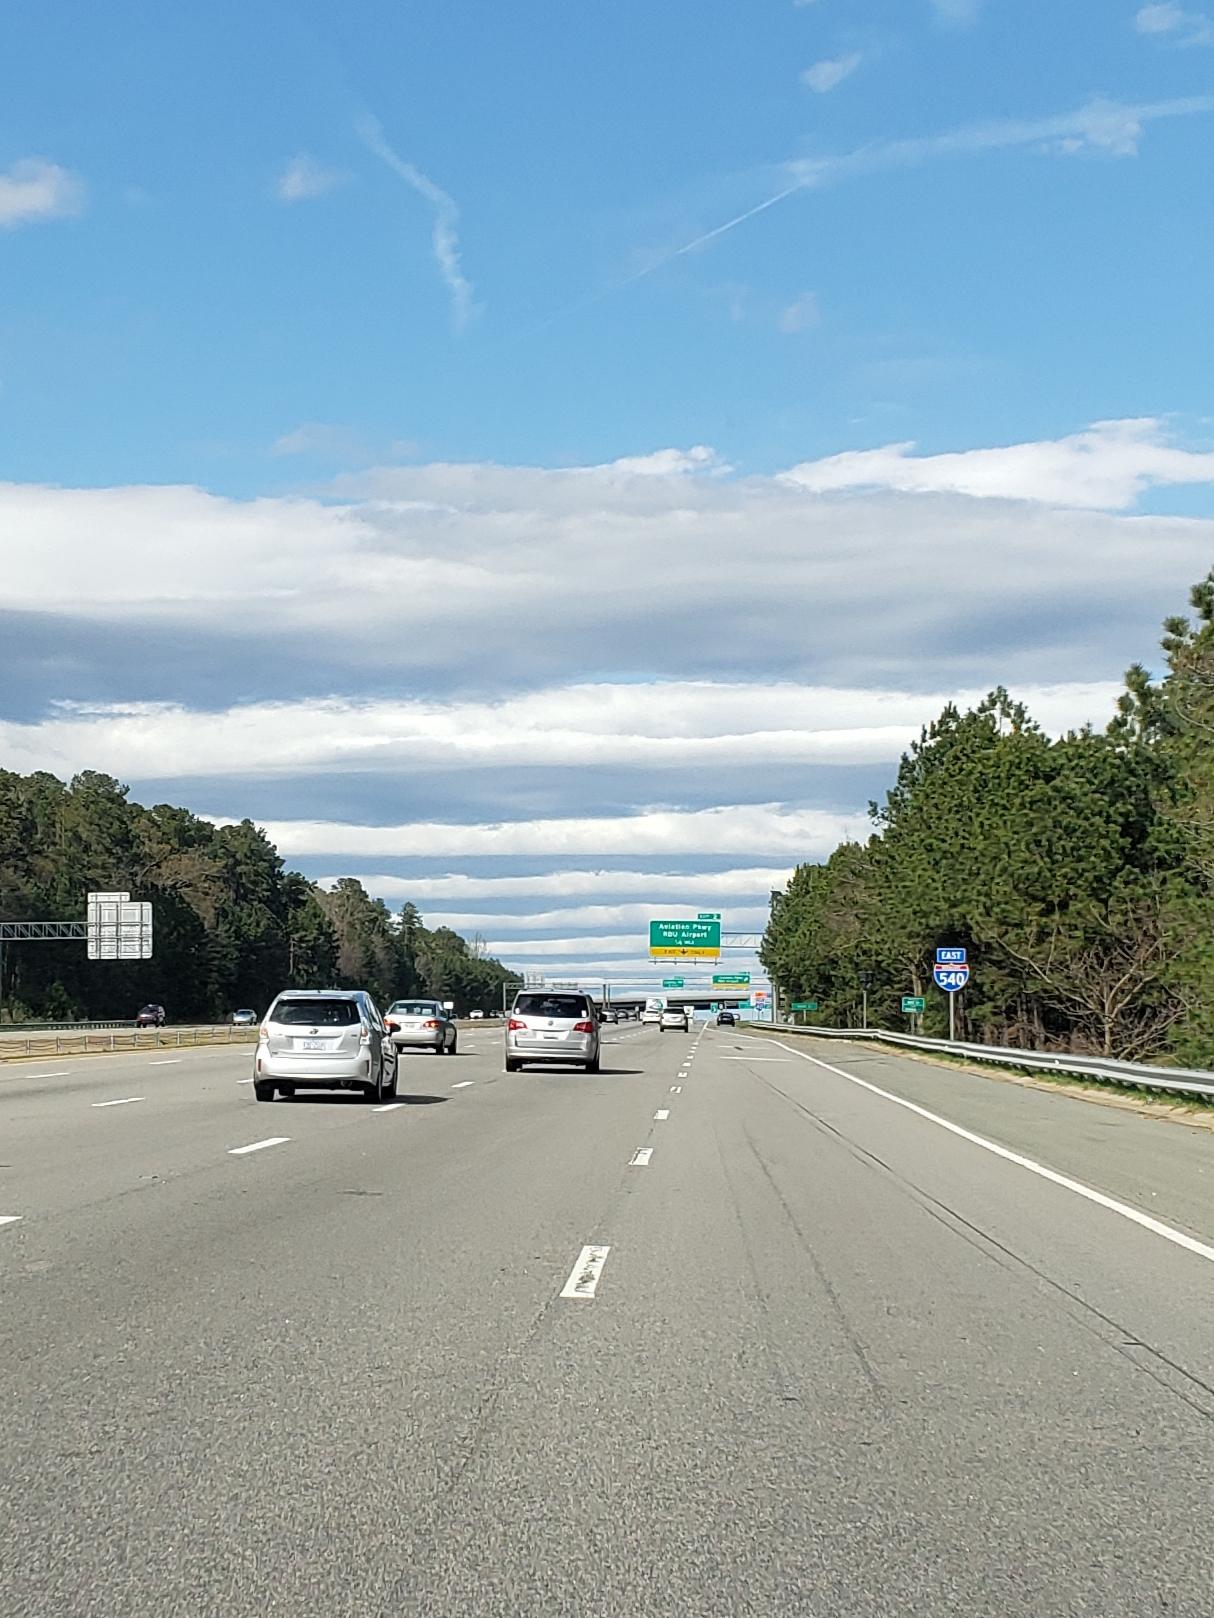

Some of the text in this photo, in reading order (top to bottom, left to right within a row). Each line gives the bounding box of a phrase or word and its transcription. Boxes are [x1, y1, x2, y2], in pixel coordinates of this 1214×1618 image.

[693, 923, 712, 932] Pkwy
[681, 931, 708, 939] Airport
[941, 951, 962, 960] EAST
[939, 972, 965, 986] 540
